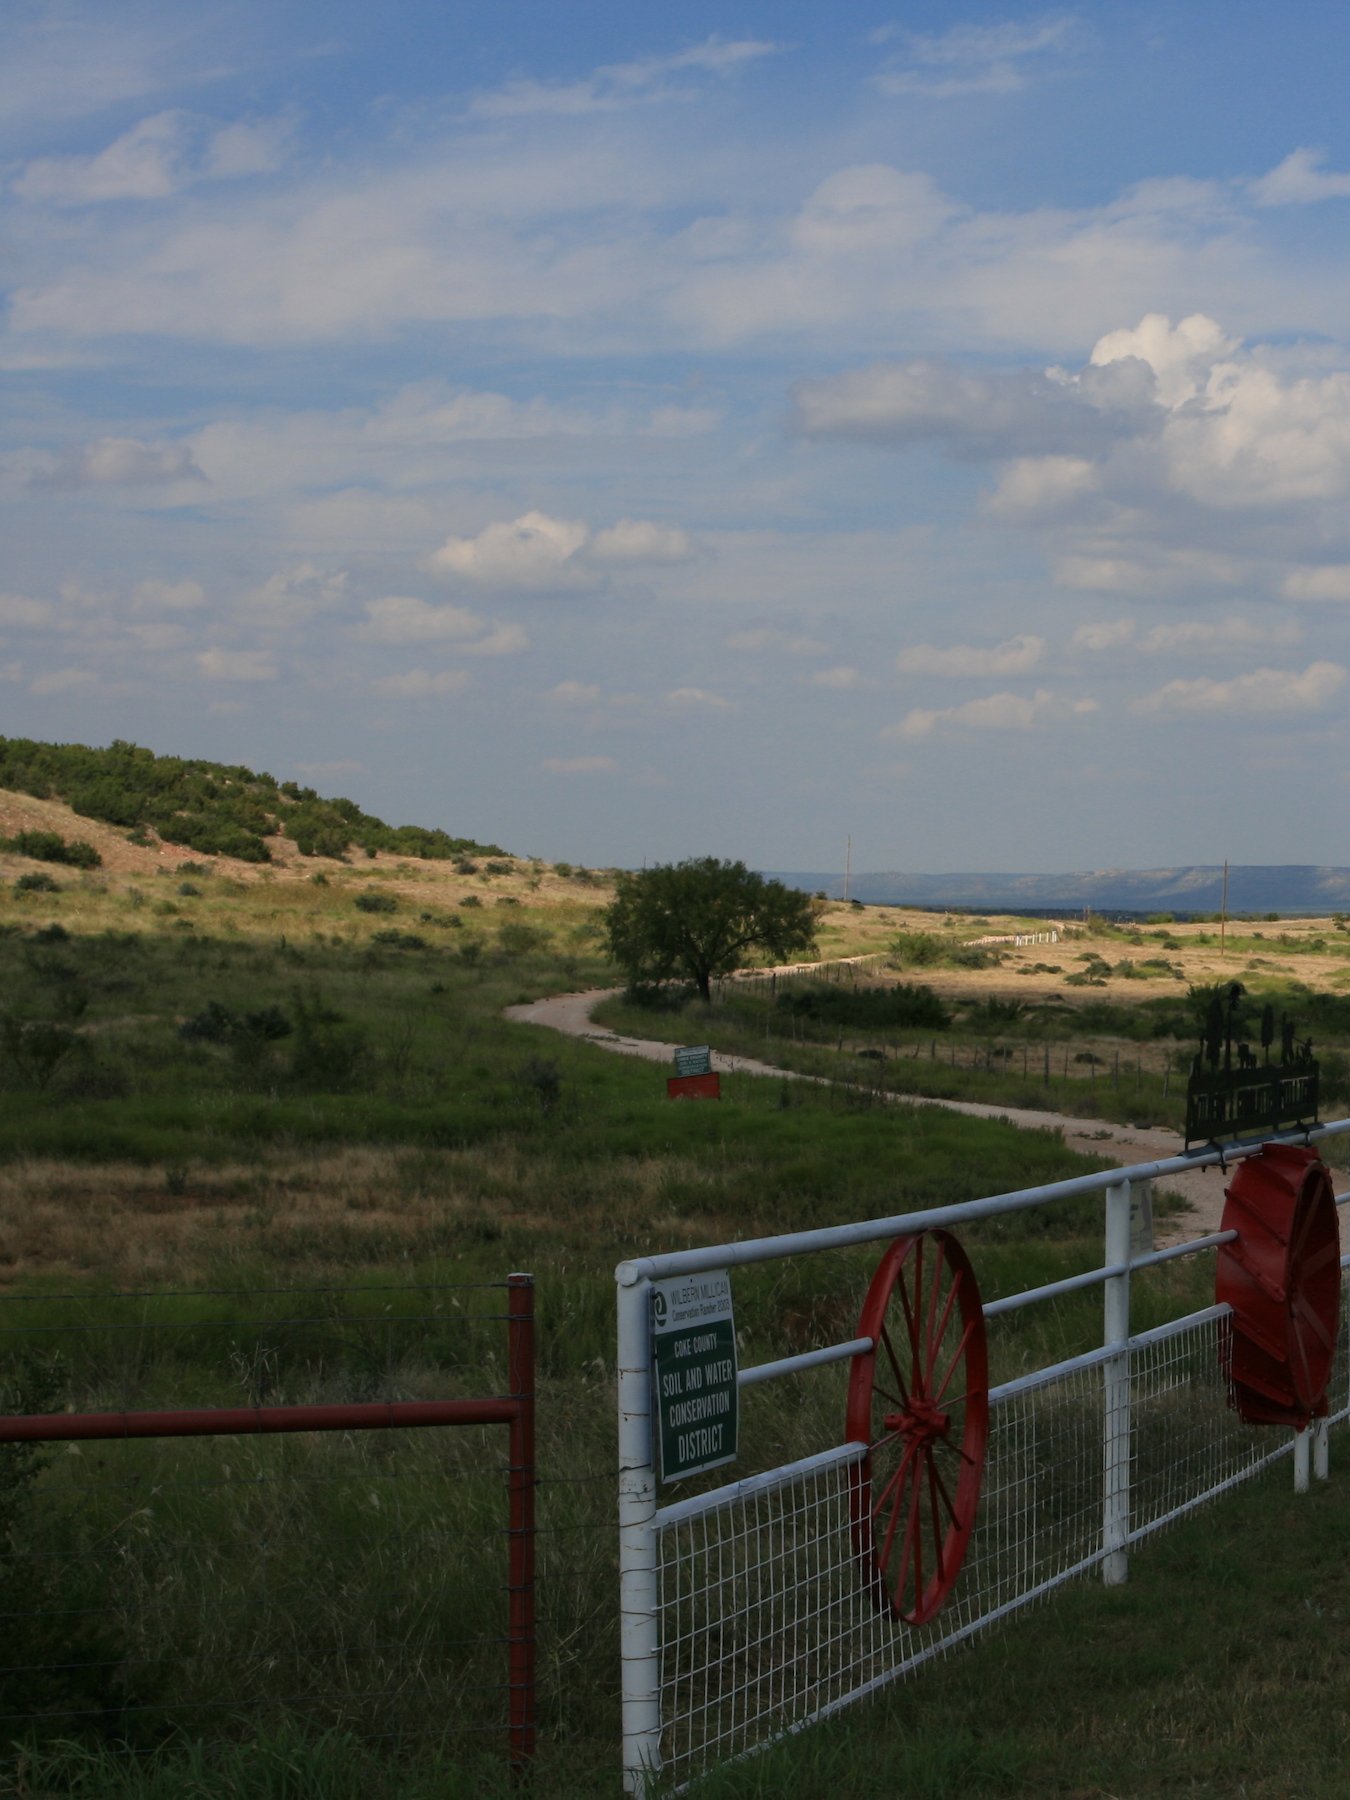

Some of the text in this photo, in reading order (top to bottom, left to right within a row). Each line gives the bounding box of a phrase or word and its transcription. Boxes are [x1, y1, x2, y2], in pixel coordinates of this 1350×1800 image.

[671, 1279, 729, 1305] WILBERN MILLICAN
[674, 1333, 717, 1358] COKE COUNTY
[663, 1359, 733, 1398] SOIL AND WATER
[669, 1390, 730, 1428] CONSERVATION
[678, 1423, 724, 1464] DISTRICT
